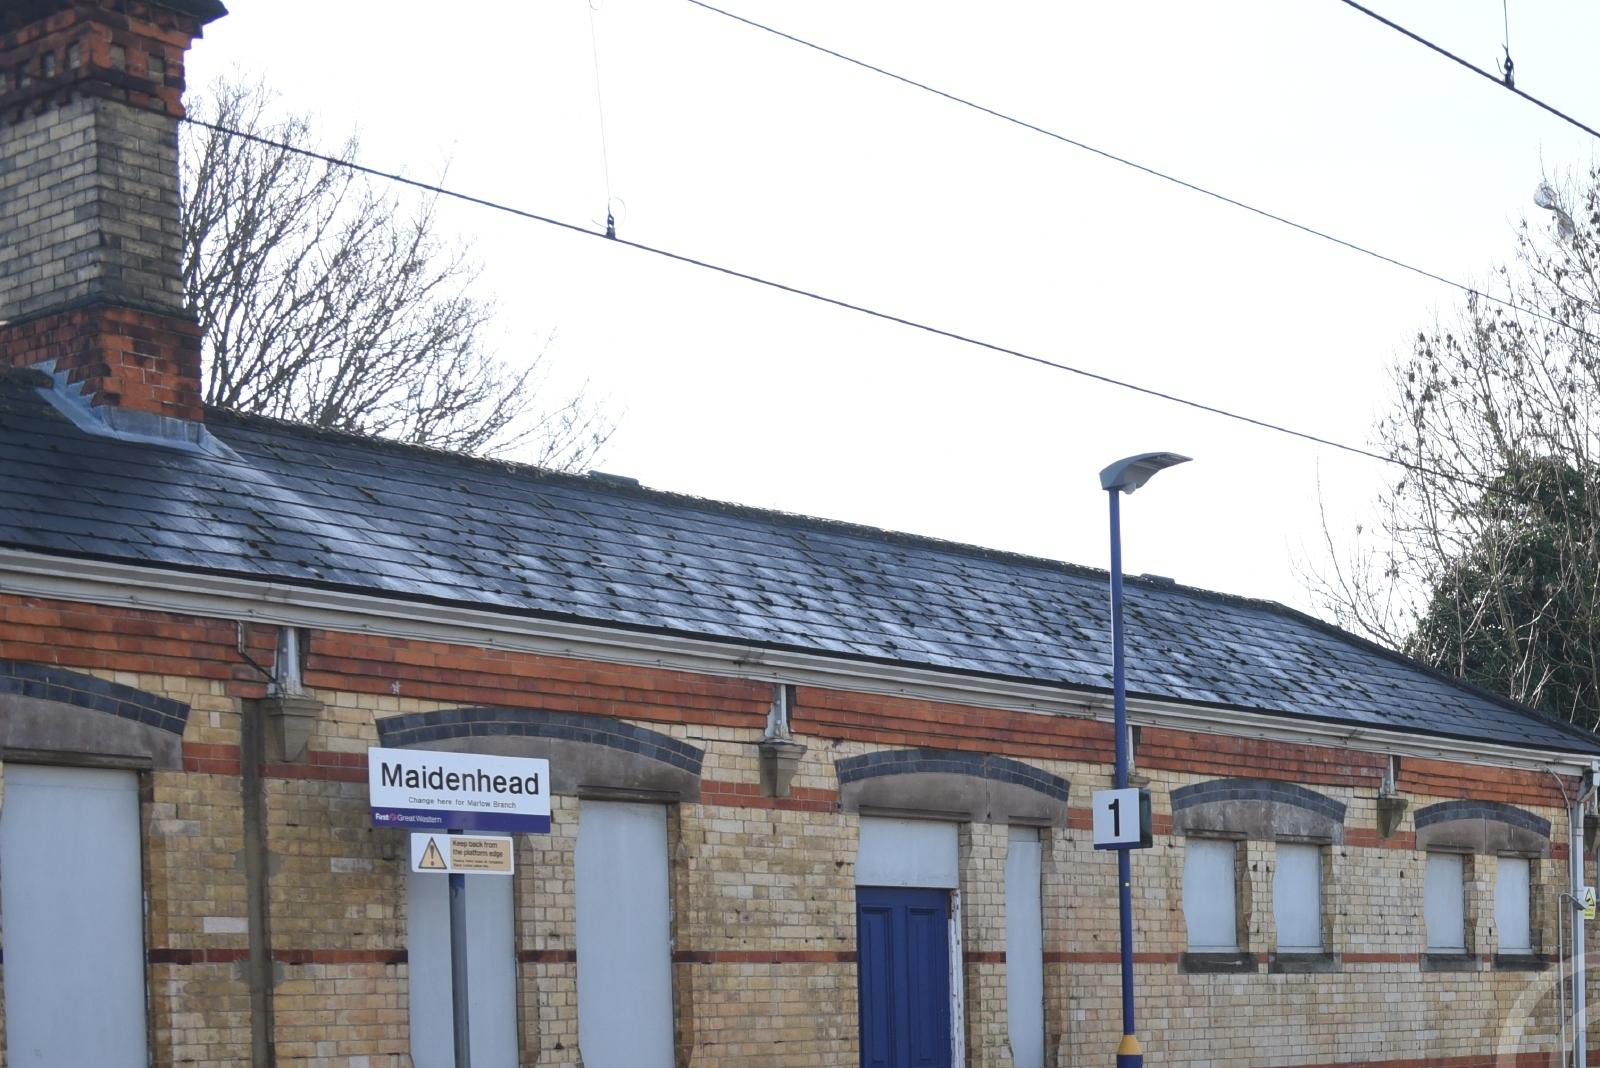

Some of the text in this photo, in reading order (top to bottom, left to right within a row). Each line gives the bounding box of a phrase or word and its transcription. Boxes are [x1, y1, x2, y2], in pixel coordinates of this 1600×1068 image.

[381, 762, 539, 795] Maidenhead
[408, 796, 434, 805] Change
[455, 798, 464, 806] for
[467, 799, 491, 807] Marlow
[493, 801, 517, 809] Branch
[375, 813, 442, 823] First Great Western
[1108, 798, 1120, 837] 1
